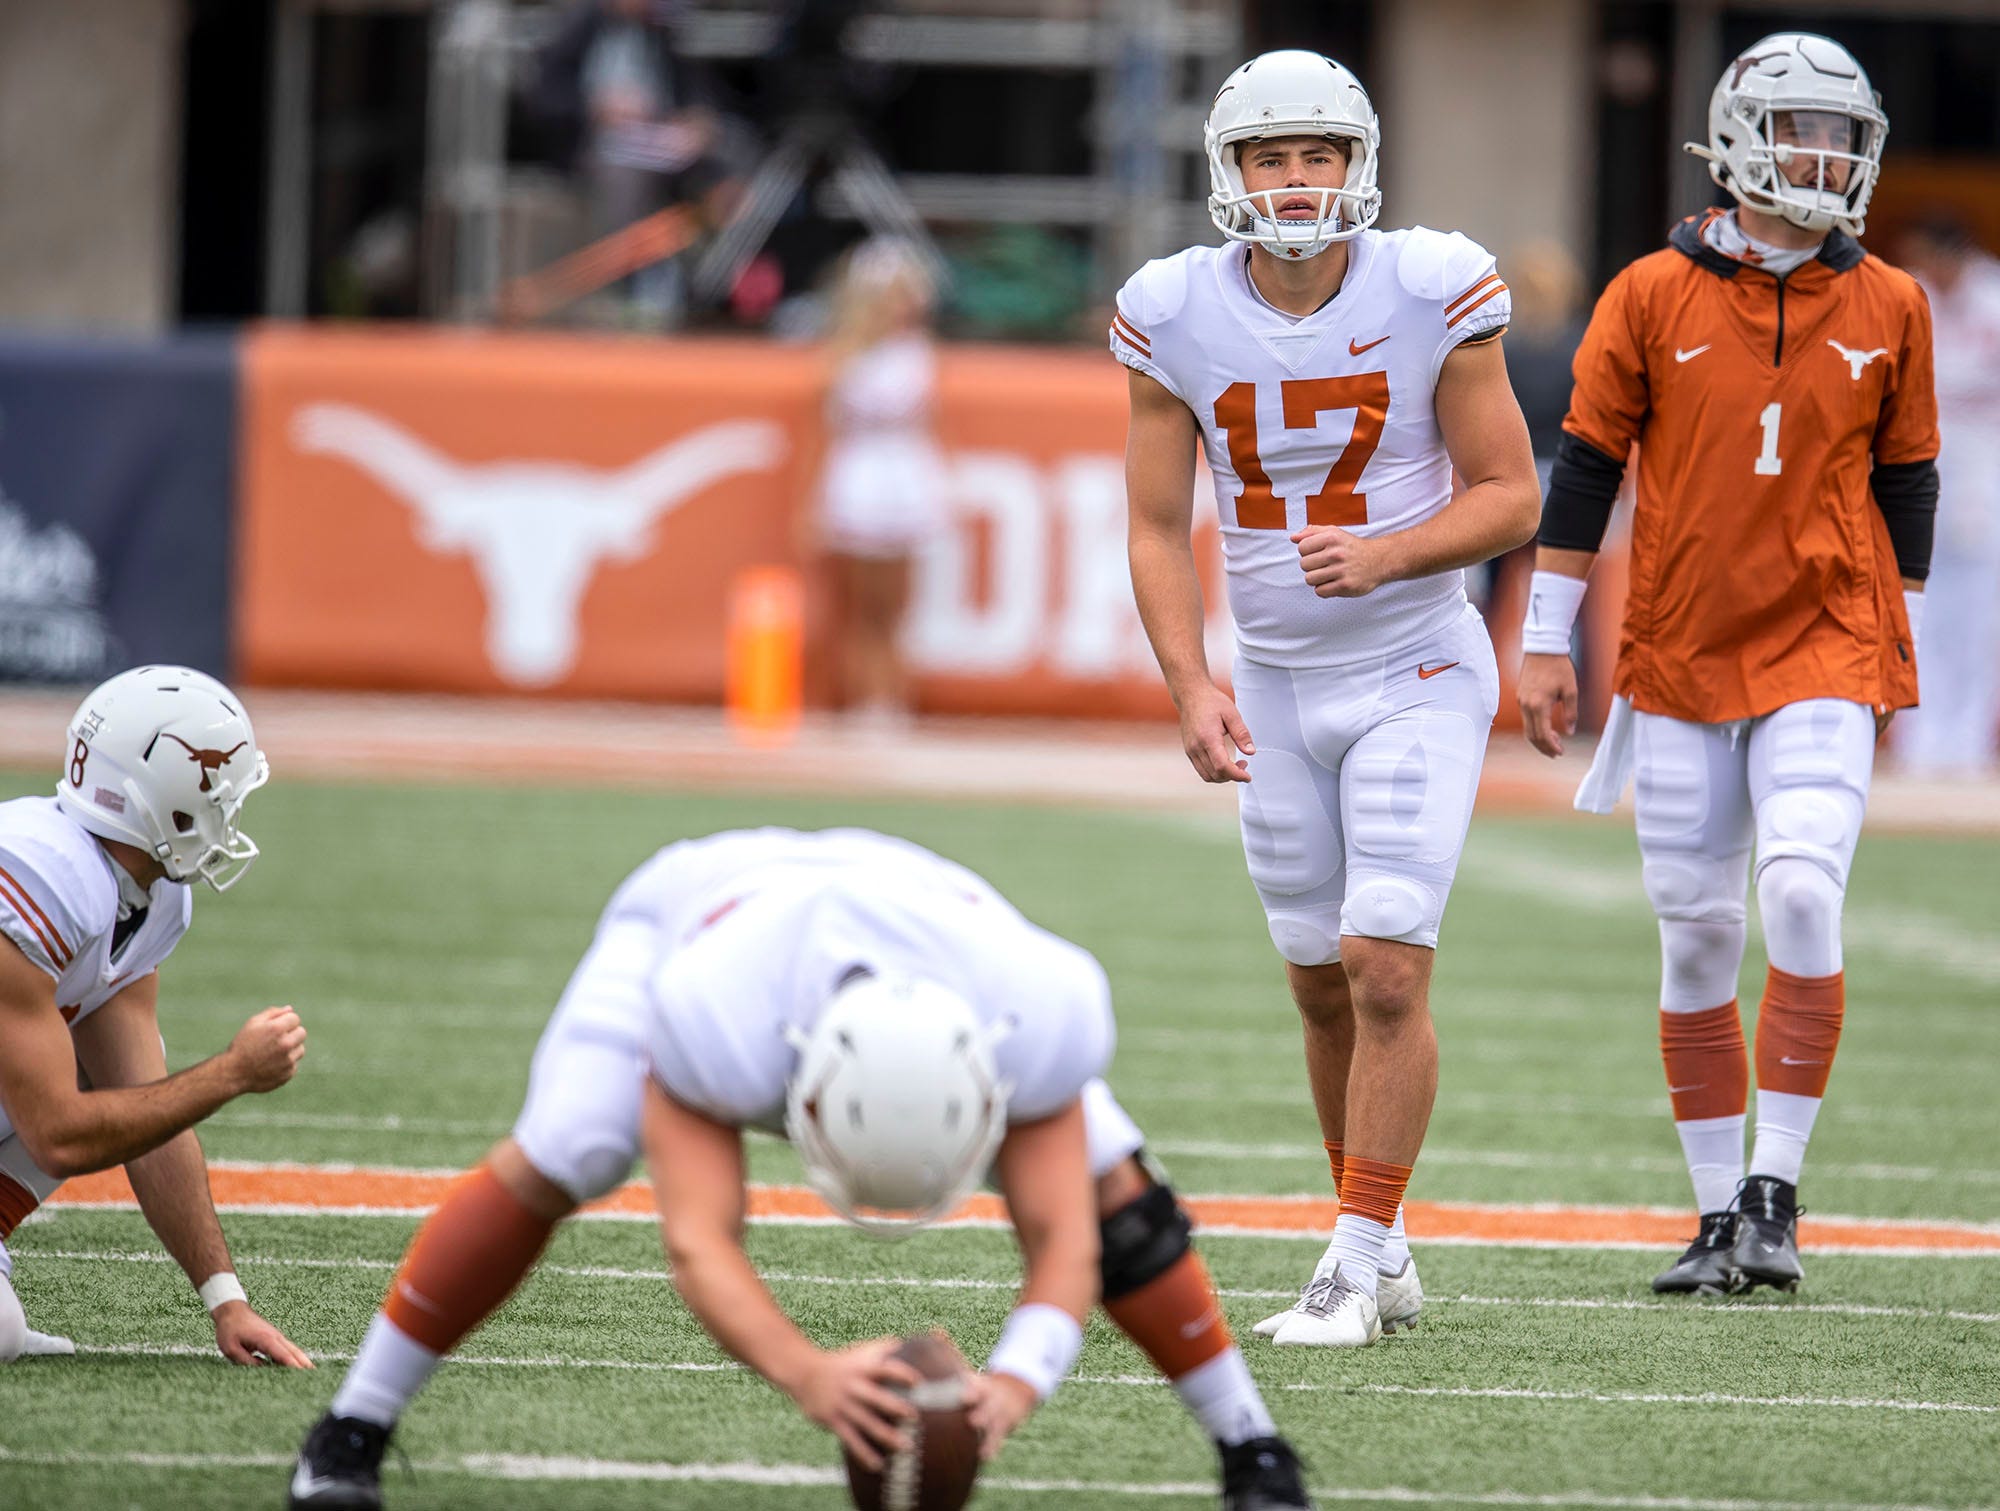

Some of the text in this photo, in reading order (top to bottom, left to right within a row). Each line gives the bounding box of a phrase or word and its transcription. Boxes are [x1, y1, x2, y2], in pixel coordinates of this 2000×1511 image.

[1213, 370, 1390, 529] 17
[1754, 402, 1782, 475] 1
[71, 738, 88, 789] 8
